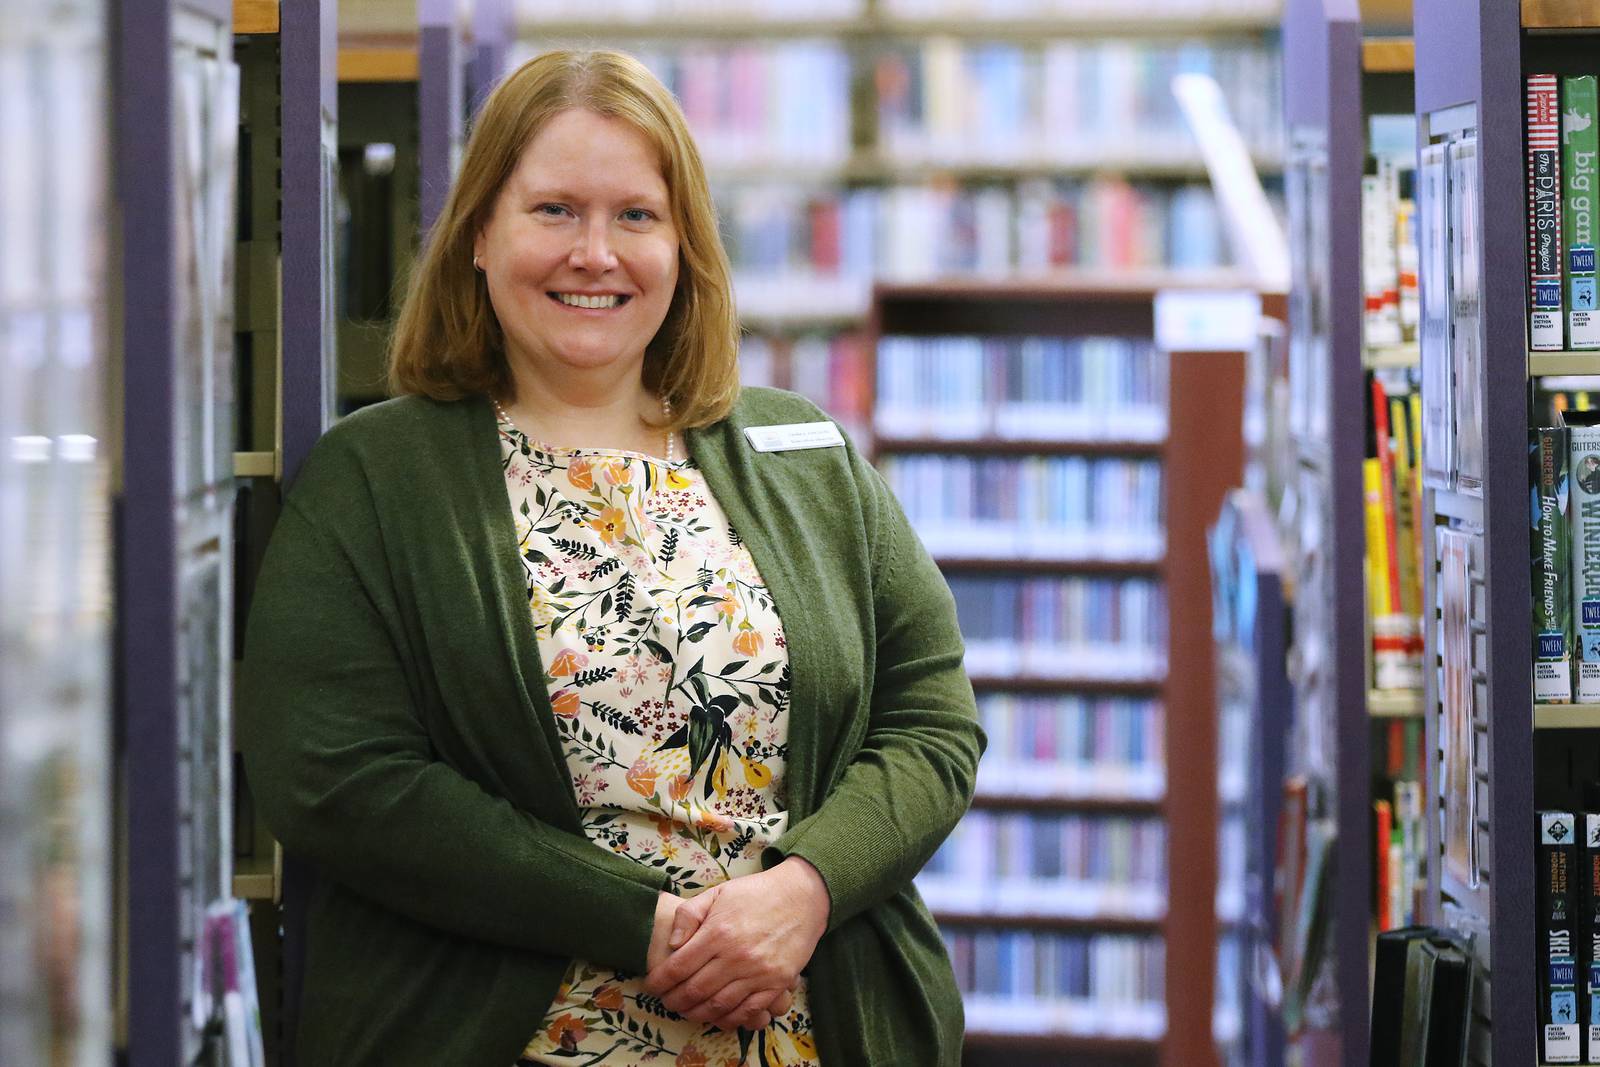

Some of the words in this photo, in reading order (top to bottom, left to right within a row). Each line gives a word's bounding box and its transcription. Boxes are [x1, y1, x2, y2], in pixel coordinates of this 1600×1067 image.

[1540, 153, 1550, 174] The
[1570, 151, 1596, 192] big
[1536, 176, 1555, 230] PARIS
[1539, 233, 1551, 272] Project
[1572, 255, 1594, 268] TWEEN
[1539, 289, 1559, 302] TWEEN
[1543, 436, 1554, 486] GUERRERO
[1543, 537, 1557, 571] MAKE
[1543, 571, 1558, 617] FRIENDS
[1541, 640, 1562, 652] TWEEN
[1553, 967, 1574, 980] TWEEN
